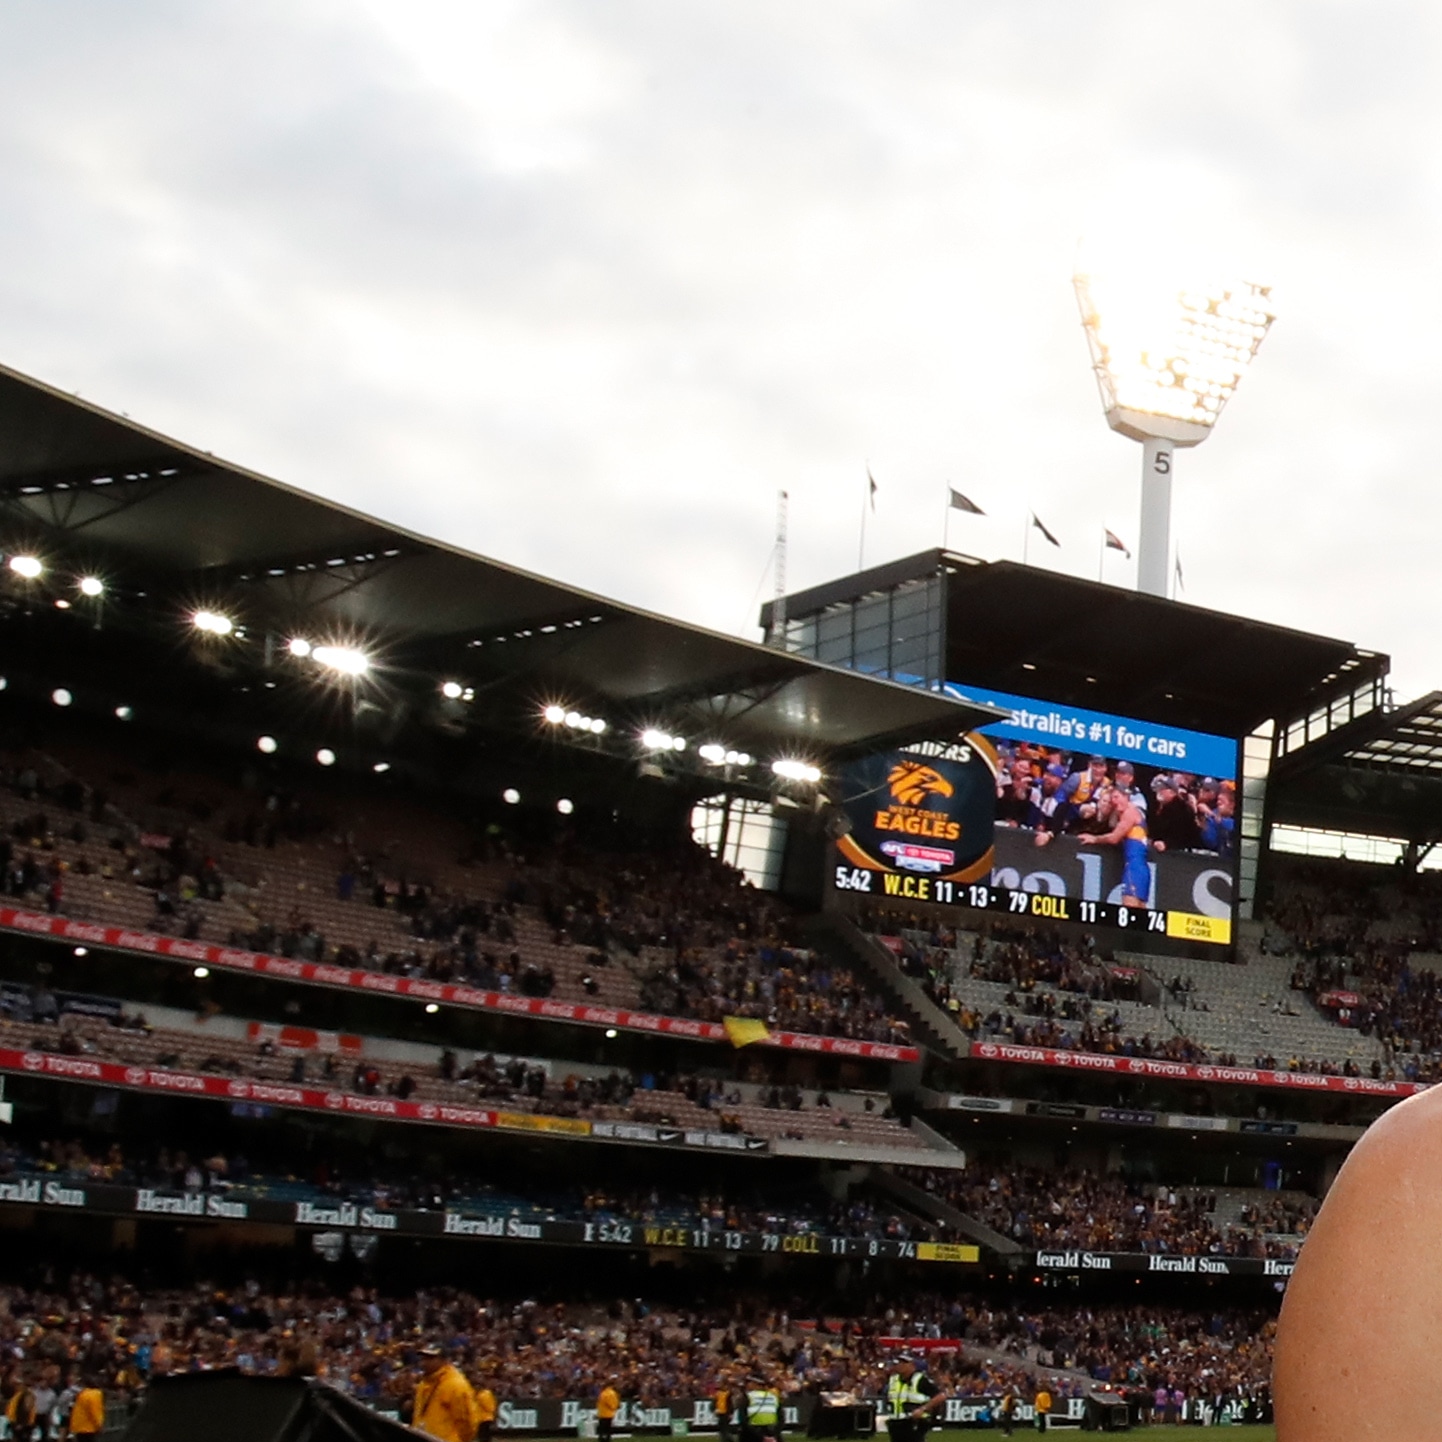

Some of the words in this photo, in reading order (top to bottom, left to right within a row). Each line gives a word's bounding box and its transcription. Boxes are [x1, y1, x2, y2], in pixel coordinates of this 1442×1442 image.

[999, 708, 1086, 739] stralia's
[1089, 721, 1112, 744] #1
[1116, 726, 1145, 750] for
[1147, 737, 1186, 759] cars
[876, 811, 960, 841] EAGLES
[836, 866, 872, 892] 5:42
[884, 873, 930, 900] W.C.E
[1009, 891, 1028, 913] 79
[1032, 895, 1069, 919] COLL
[1148, 910, 1165, 932] 74
[1185, 917, 1211, 928] FINAL
[1000, 1047, 1045, 1061] TOYOTA
[1073, 1055, 1116, 1068] TOYOTA
[48, 1055, 101, 1077] TOYOTA
[1146, 1063, 1188, 1076] TOYOTA
[149, 1072, 204, 1091] TOYOTA
[1216, 1069, 1259, 1082] TOYOTA
[1290, 1075, 1328, 1087] TOYOTA
[252, 1085, 300, 1102] TOYOTA
[346, 1097, 396, 1114] TOYOTA
[440, 1108, 489, 1124] TOYOTA
[45, 1182, 85, 1207] Sun
[136, 1188, 205, 1216] Herald
[207, 1194, 248, 1219] Sun
[295, 1202, 357, 1226] Herald
[360, 1209, 397, 1229] Sun
[444, 1212, 504, 1236] Herald
[507, 1218, 541, 1239] Sun
[762, 1235, 779, 1251] 79
[898, 1242, 914, 1258] 74
[1081, 1253, 1111, 1269] Sun
[1148, 1255, 1196, 1272] Herald
[1263, 1259, 1295, 1275] Her
[498, 1402, 537, 1428] Sun
[631, 1402, 670, 1427] Sun
